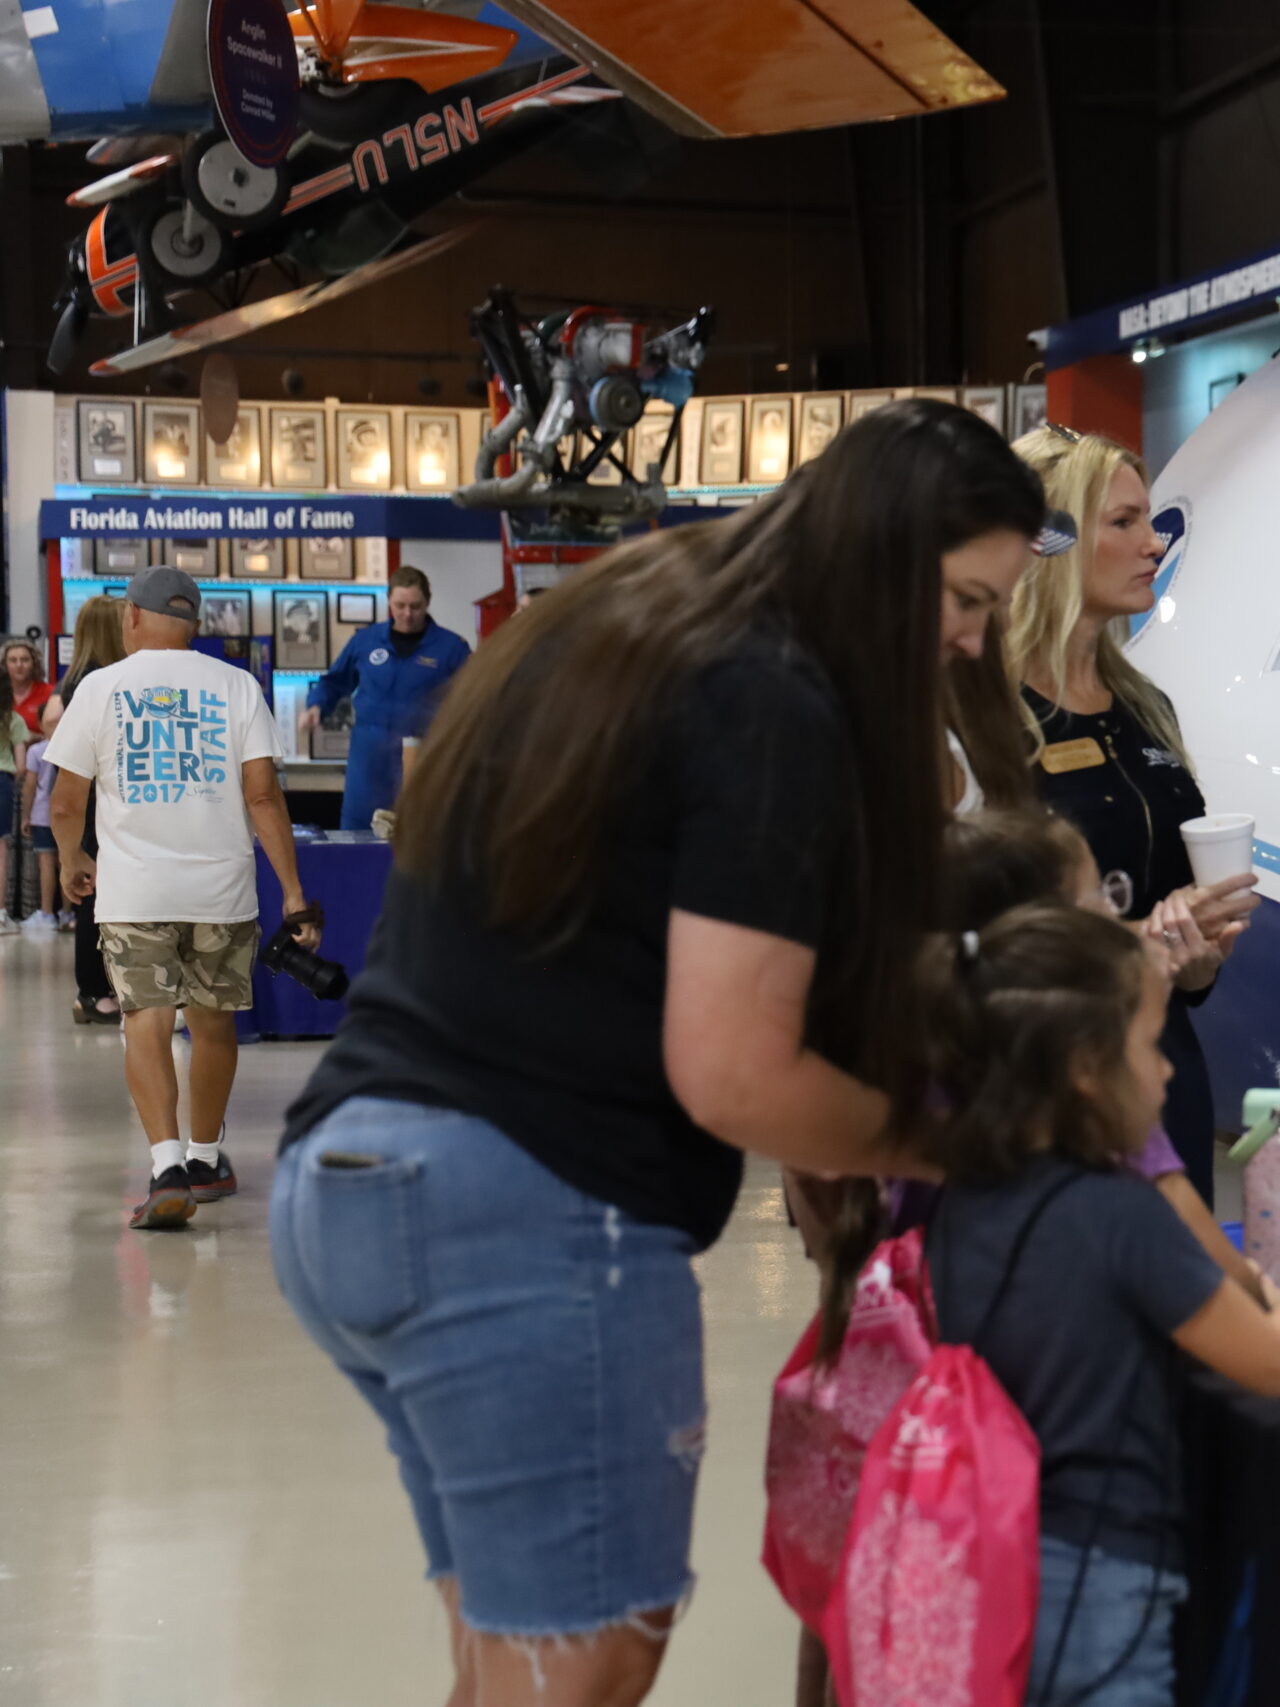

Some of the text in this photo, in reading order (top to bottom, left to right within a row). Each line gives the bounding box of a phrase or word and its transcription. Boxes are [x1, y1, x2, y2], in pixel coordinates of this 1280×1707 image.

[352, 96, 479, 191] N5LU
[70, 507, 354, 530] Florida Aviation Hall of Fame
[200, 689, 227, 783] STAFF
[127, 784, 186, 804] 2017
